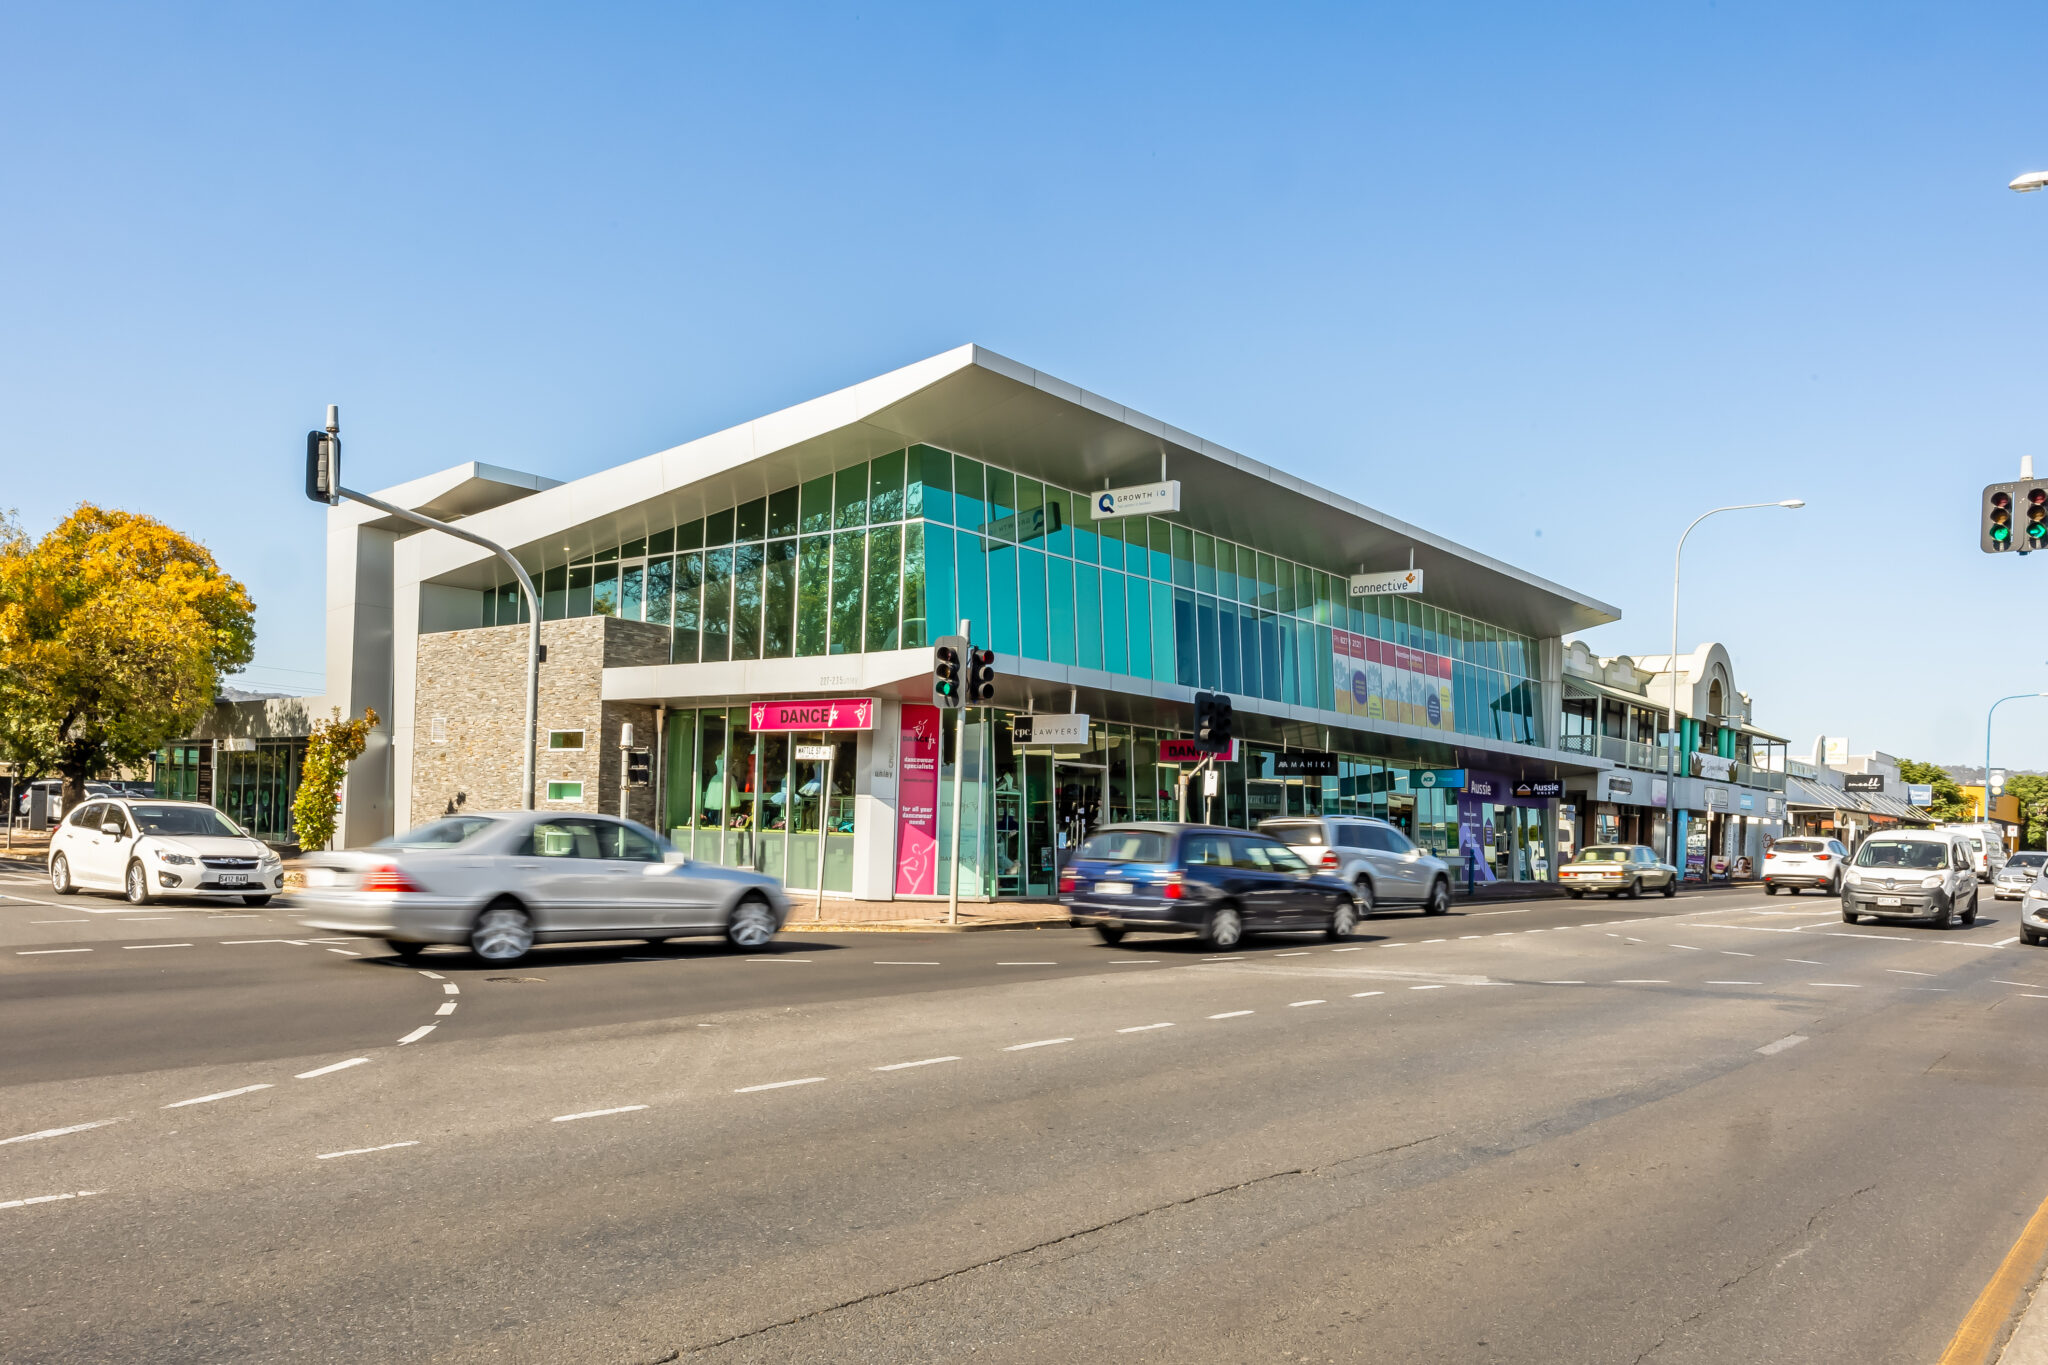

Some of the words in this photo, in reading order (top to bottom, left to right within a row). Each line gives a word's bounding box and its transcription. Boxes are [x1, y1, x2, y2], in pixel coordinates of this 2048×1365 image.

[1117, 491, 1153, 503] GROWTH
[1352, 578, 1408, 595] connective
[1033, 727, 1078, 736] LAWYERS
[1470, 780, 1492, 796] Aussie
[1533, 782, 1559, 792] Aussie
